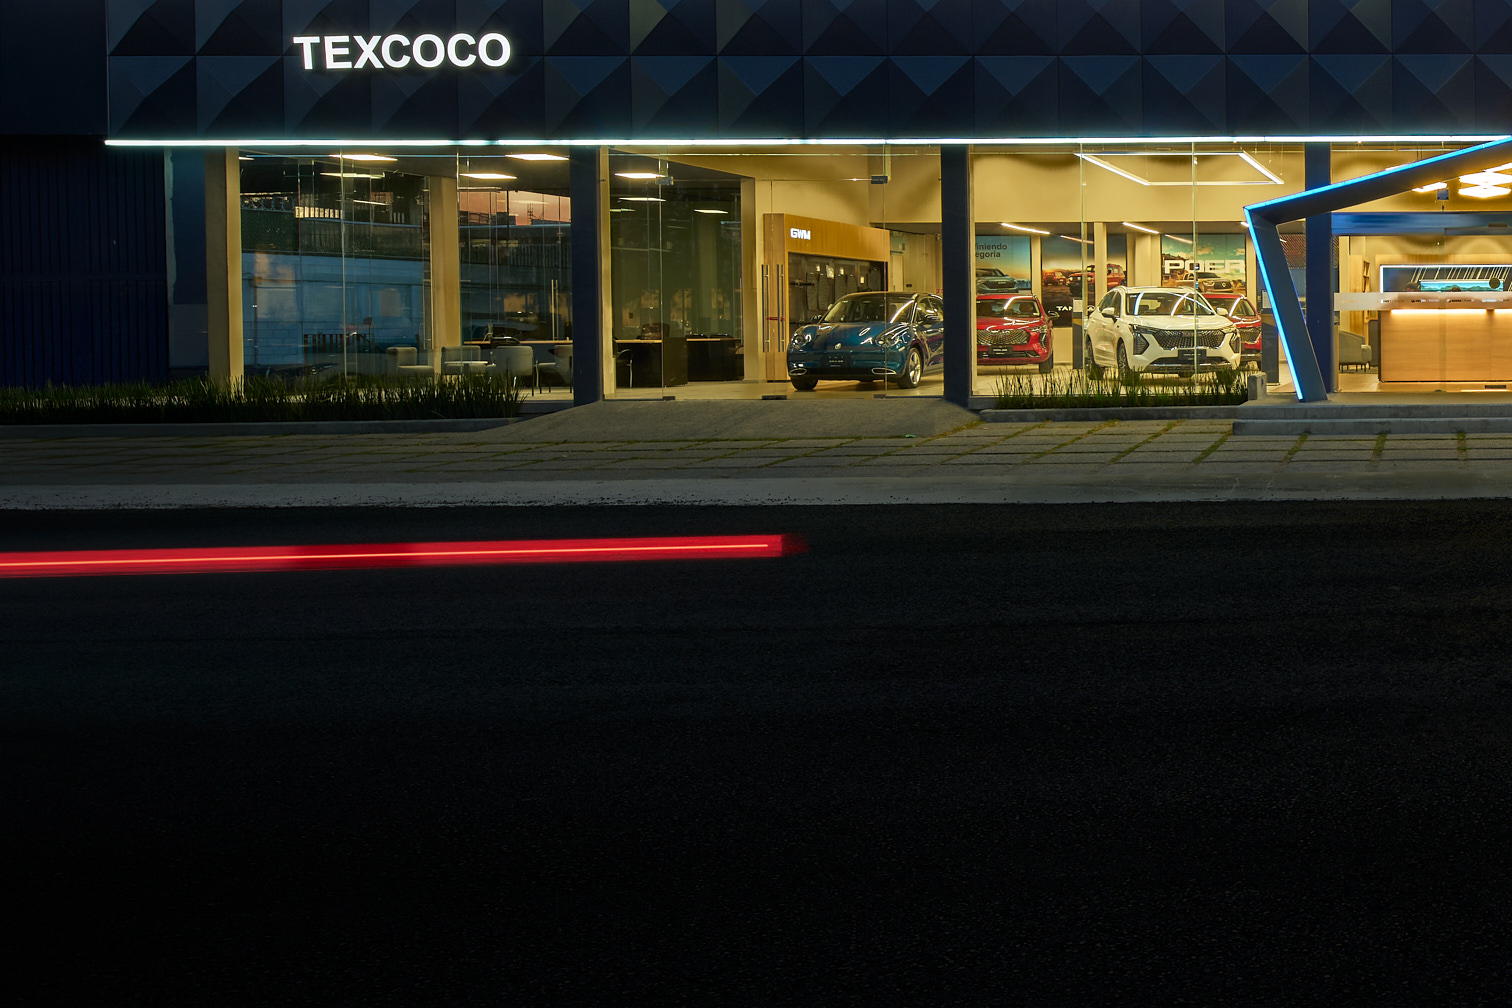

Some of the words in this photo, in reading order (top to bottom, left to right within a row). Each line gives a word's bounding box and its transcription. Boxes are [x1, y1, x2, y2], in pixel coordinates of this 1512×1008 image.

[293, 32, 511, 69] TEXCOCO
[790, 228, 811, 240] GWM
[1164, 259, 1246, 274] POER
